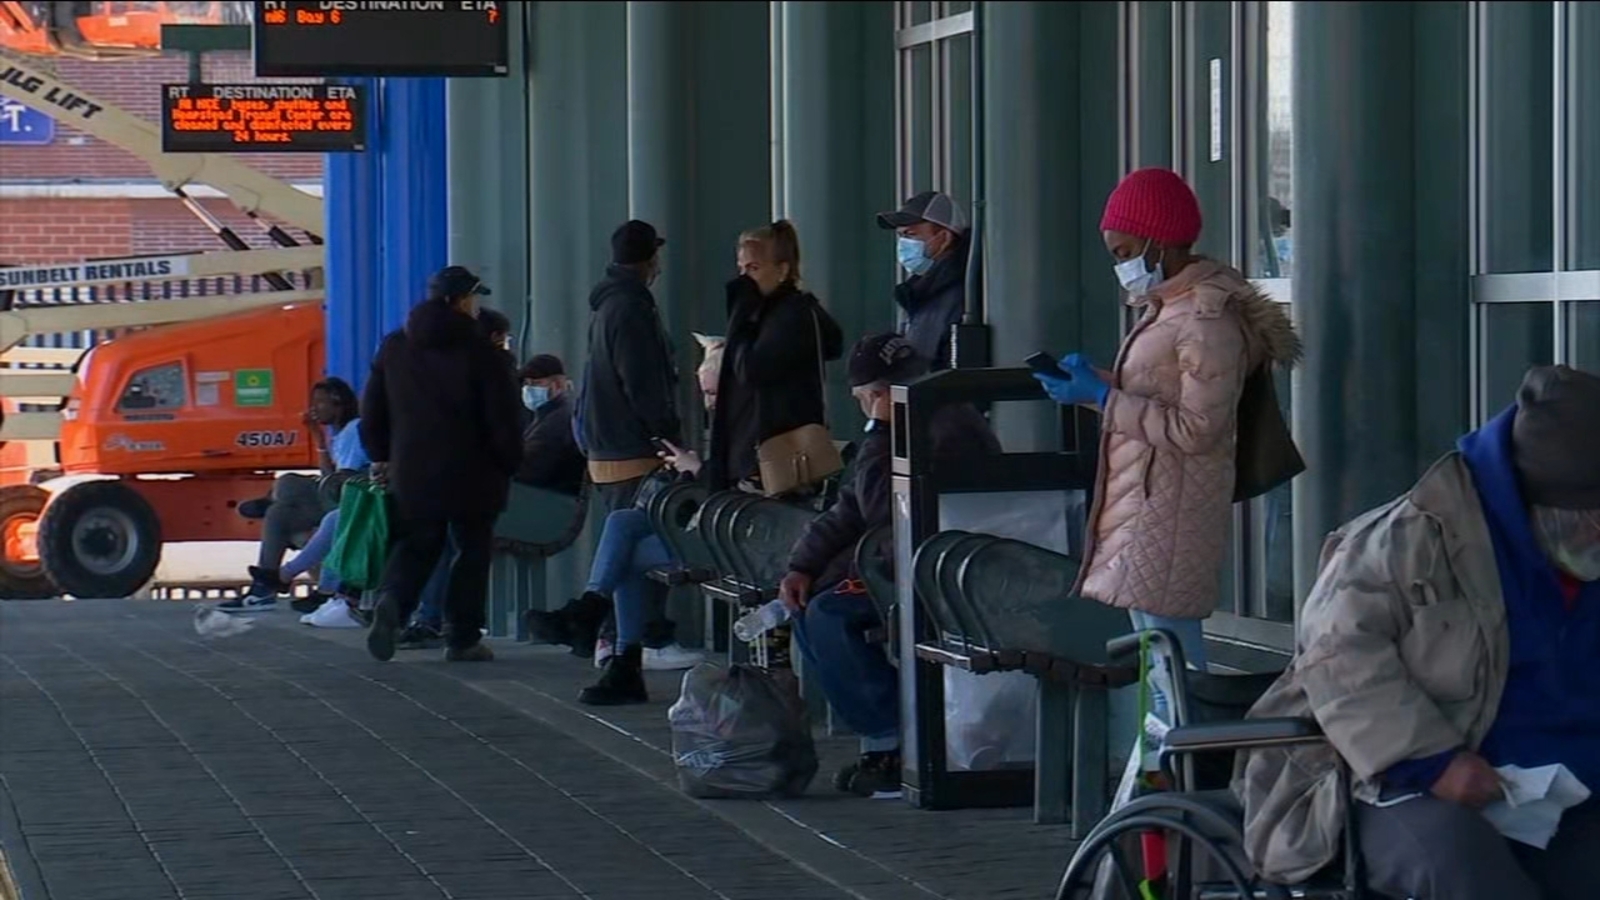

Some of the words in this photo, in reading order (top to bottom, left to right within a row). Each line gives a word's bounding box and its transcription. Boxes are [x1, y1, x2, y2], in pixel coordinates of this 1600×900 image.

[320, 1, 444, 10] DESTINATION
[297, 10, 324, 23] Bay
[330, 10, 341, 23] 6
[488, 10, 498, 23] 7
[169, 86, 189, 98] RT
[213, 86, 314, 99] DESTINATION
[327, 86, 356, 99] ETA
[43, 87, 103, 118] LIFT
[324, 99, 347, 110] and
[330, 110, 352, 120] are
[222, 120, 245, 131] and
[317, 121, 352, 131] every
[233, 130, 250, 142] 24
[0, 265, 80, 286] SUNBELT
[84, 260, 171, 281] RENTALS
[236, 430, 298, 447] 450AJ
